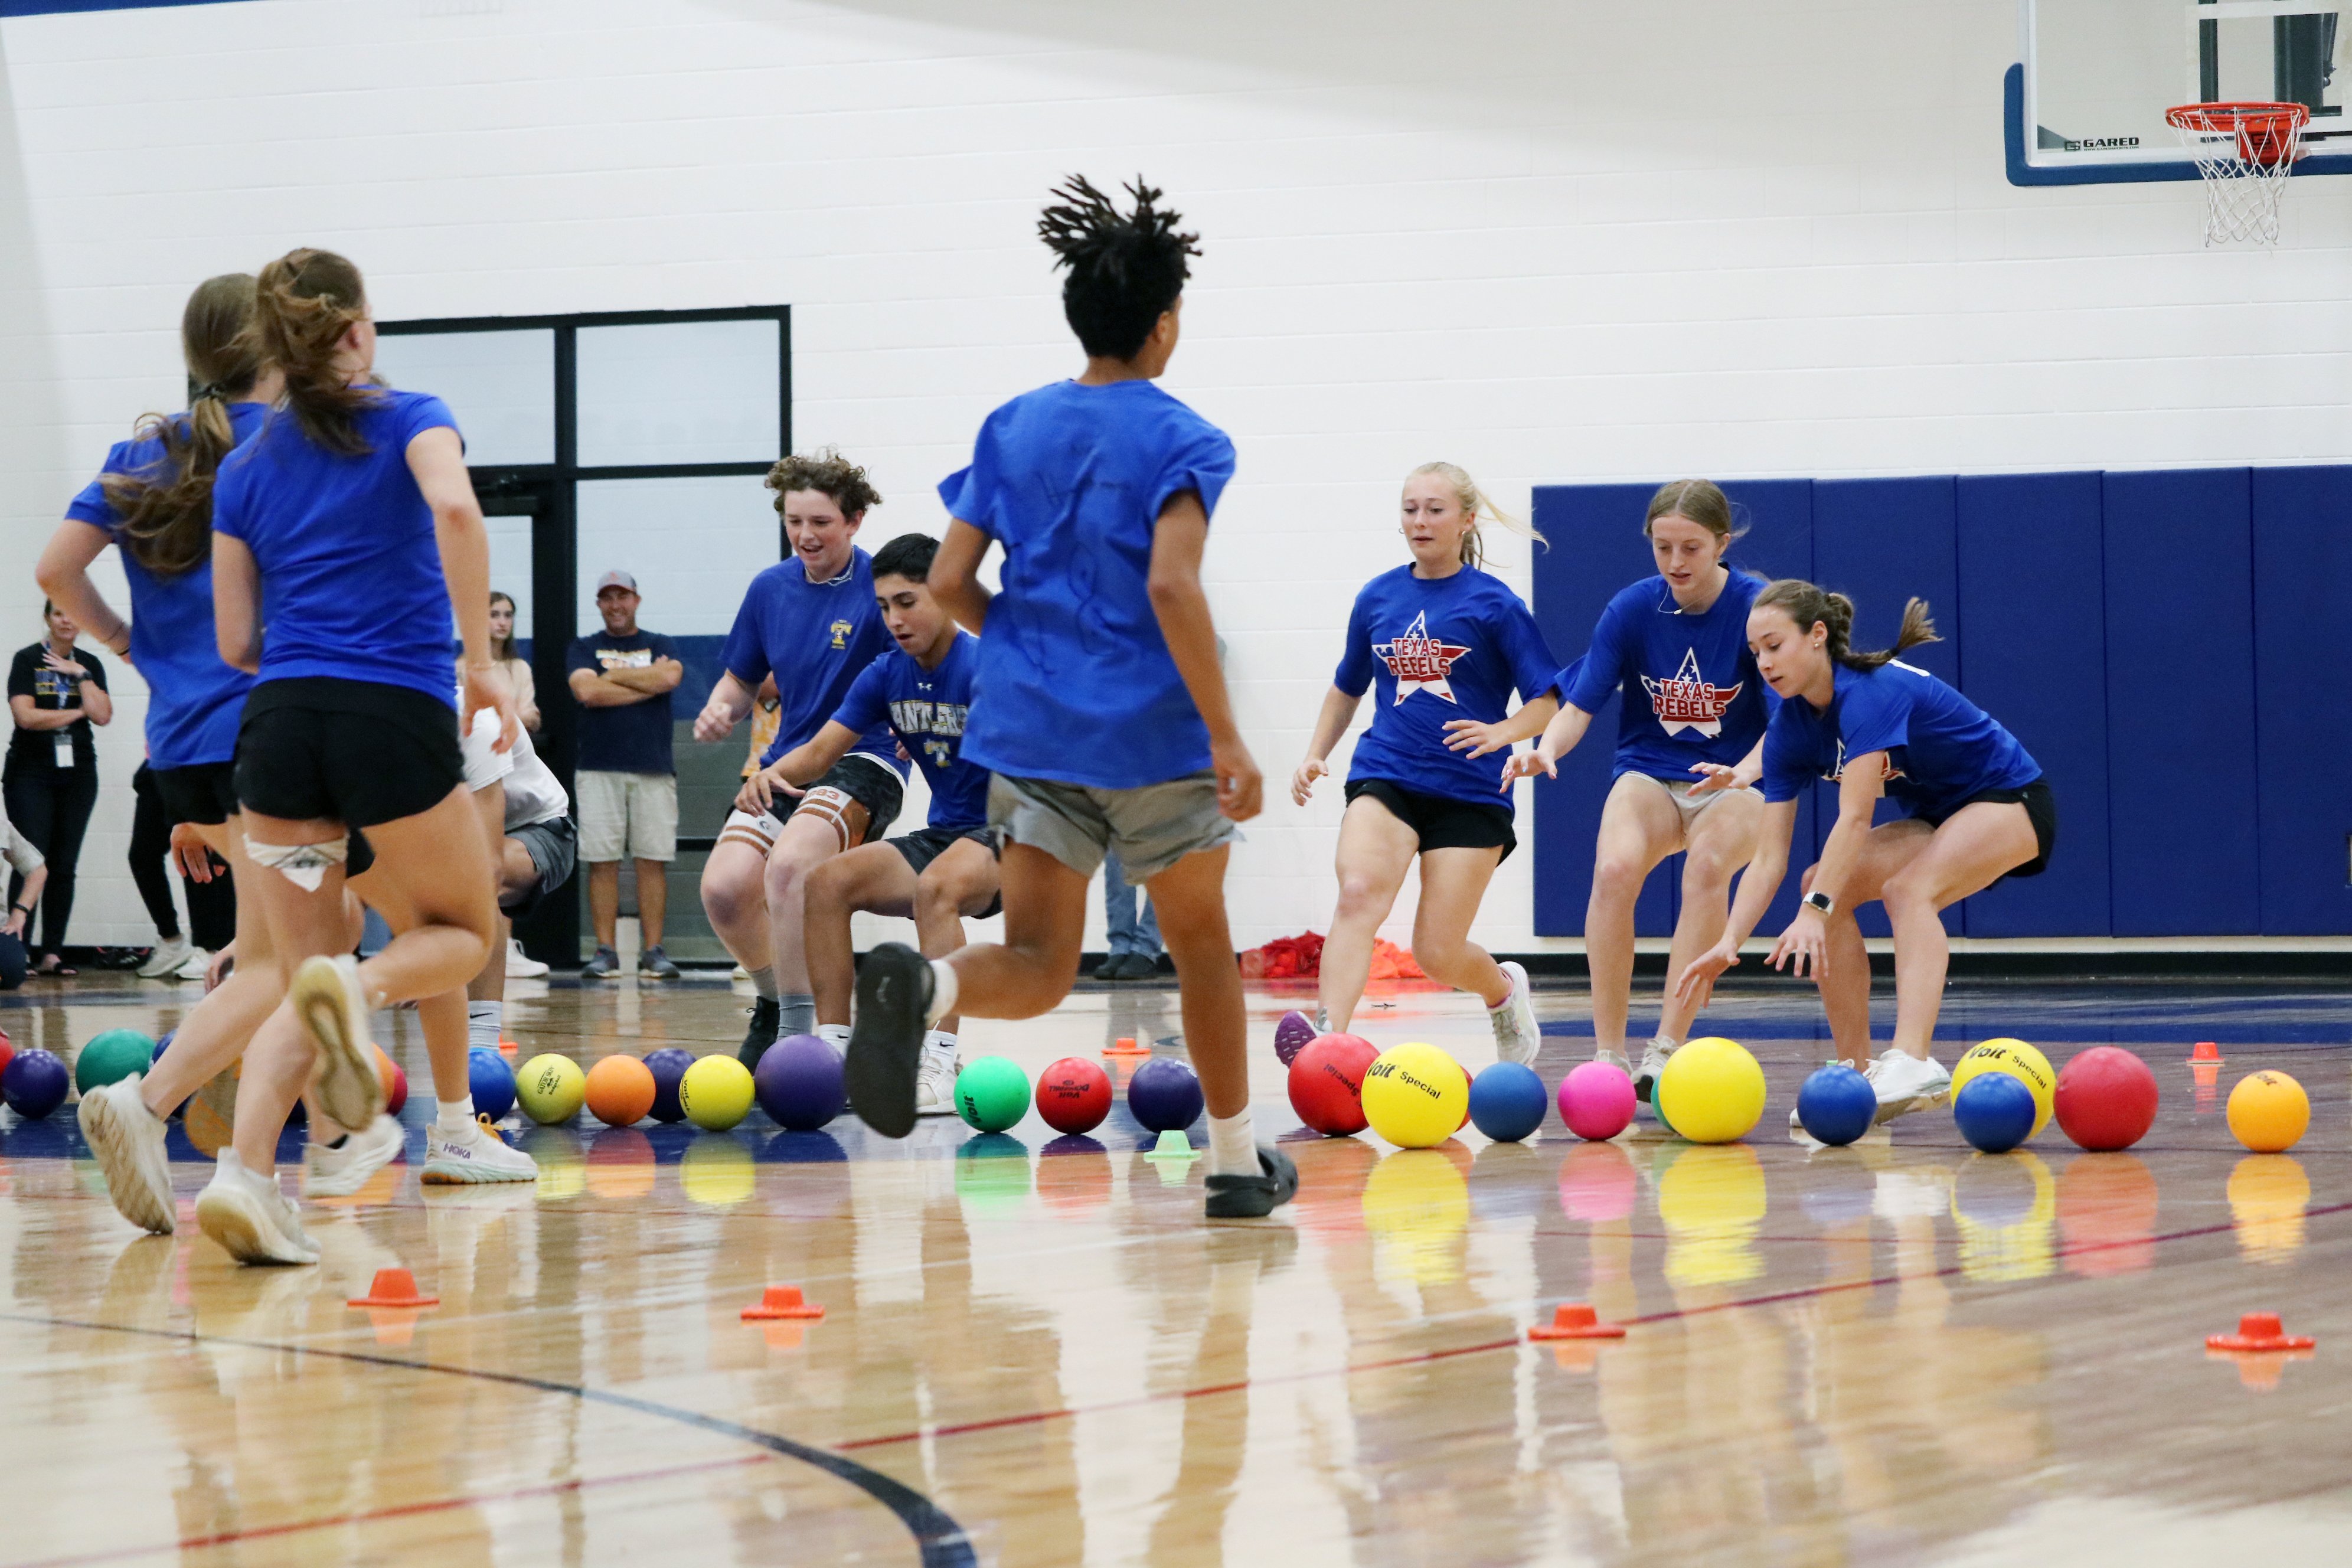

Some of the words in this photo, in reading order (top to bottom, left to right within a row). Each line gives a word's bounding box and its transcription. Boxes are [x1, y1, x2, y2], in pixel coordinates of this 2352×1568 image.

[2083, 136, 2139, 148] GARED
[1392, 638, 1441, 657] TEXAS
[1661, 679, 1714, 701] TEXAS
[1654, 694, 1726, 717] REBELS
[1969, 1046, 2007, 1059] Voit
[2012, 1055, 2047, 1089] Special
[1324, 1063, 1359, 1097] Special
[1367, 1061, 1397, 1078] Voit
[1400, 1071, 1441, 1100] Special
[963, 1095, 983, 1123] Voit
[443, 1142, 471, 1159] HOKA
